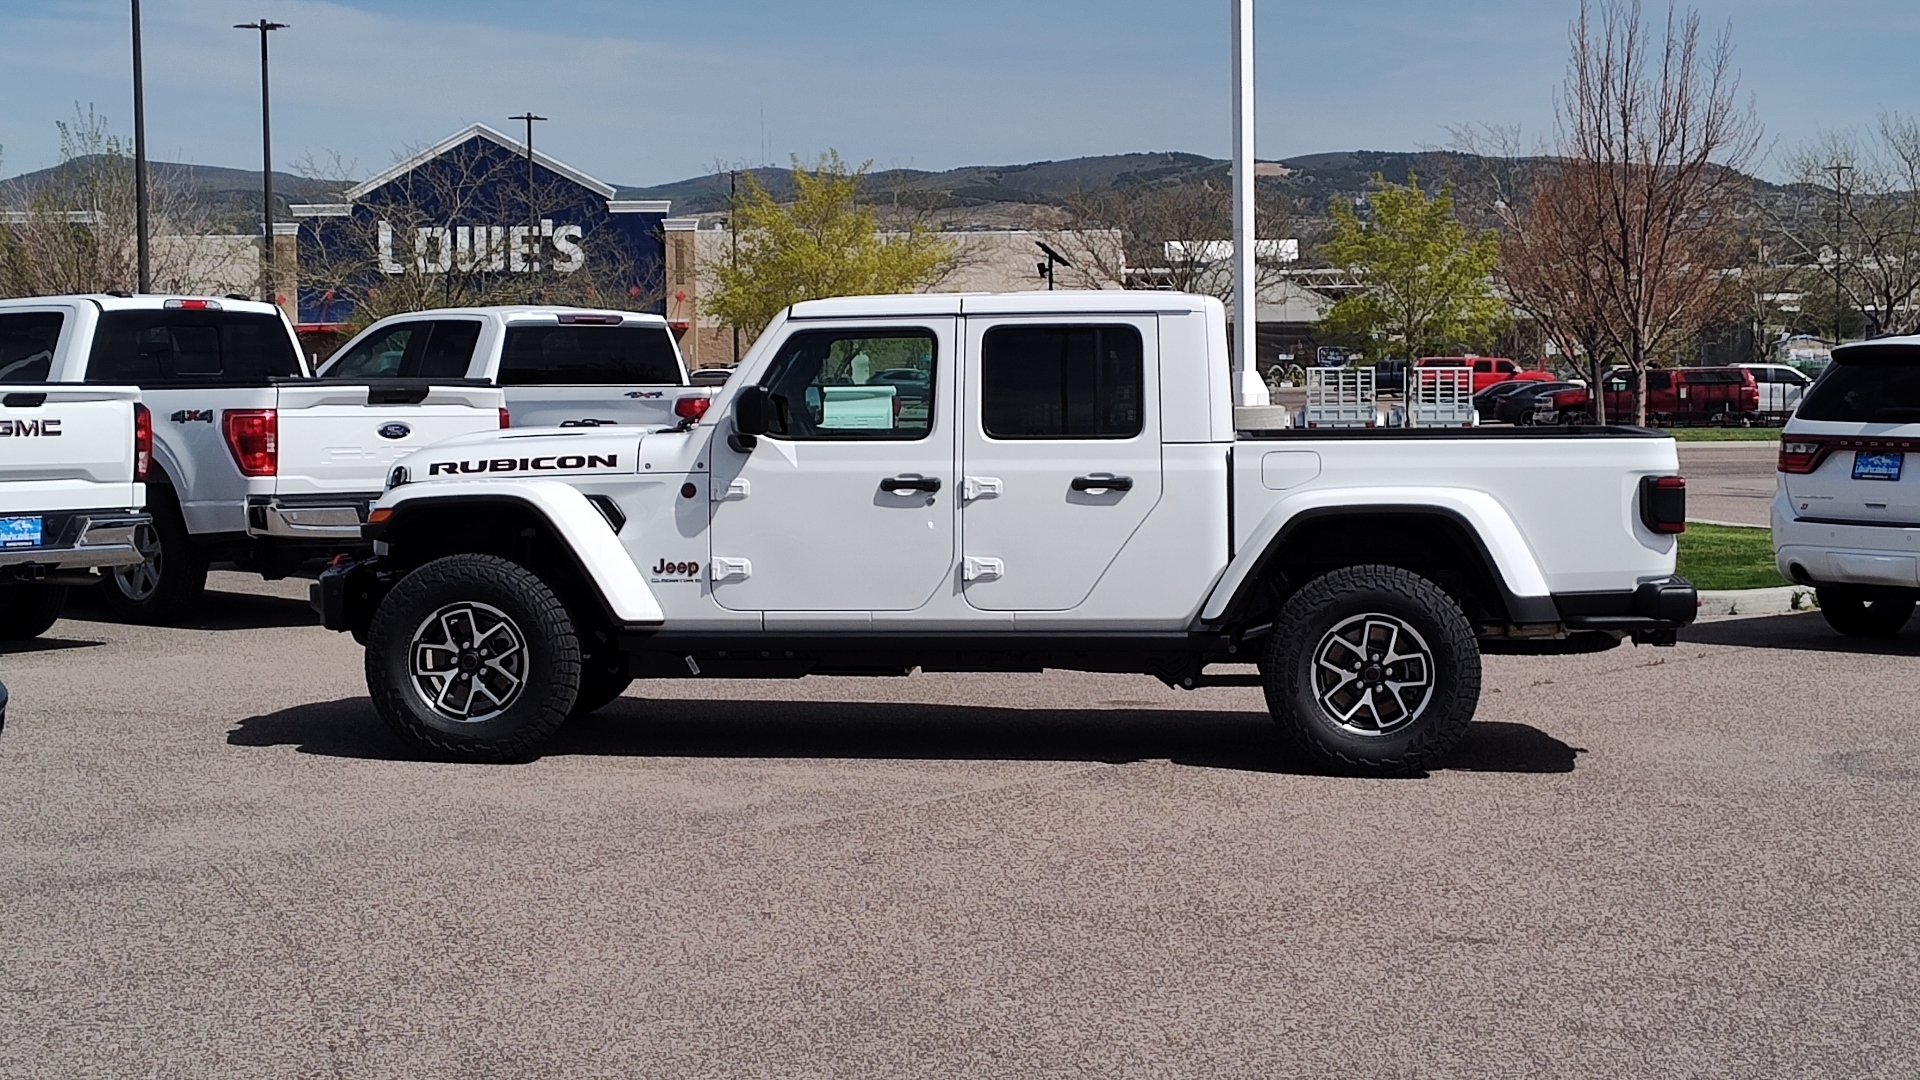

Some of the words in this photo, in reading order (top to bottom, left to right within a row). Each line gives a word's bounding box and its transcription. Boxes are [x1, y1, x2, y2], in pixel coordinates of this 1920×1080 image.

[377, 219, 585, 274] LOWE'S
[429, 454, 618, 476] RUBICON
[652, 558, 700, 577] Jeep
